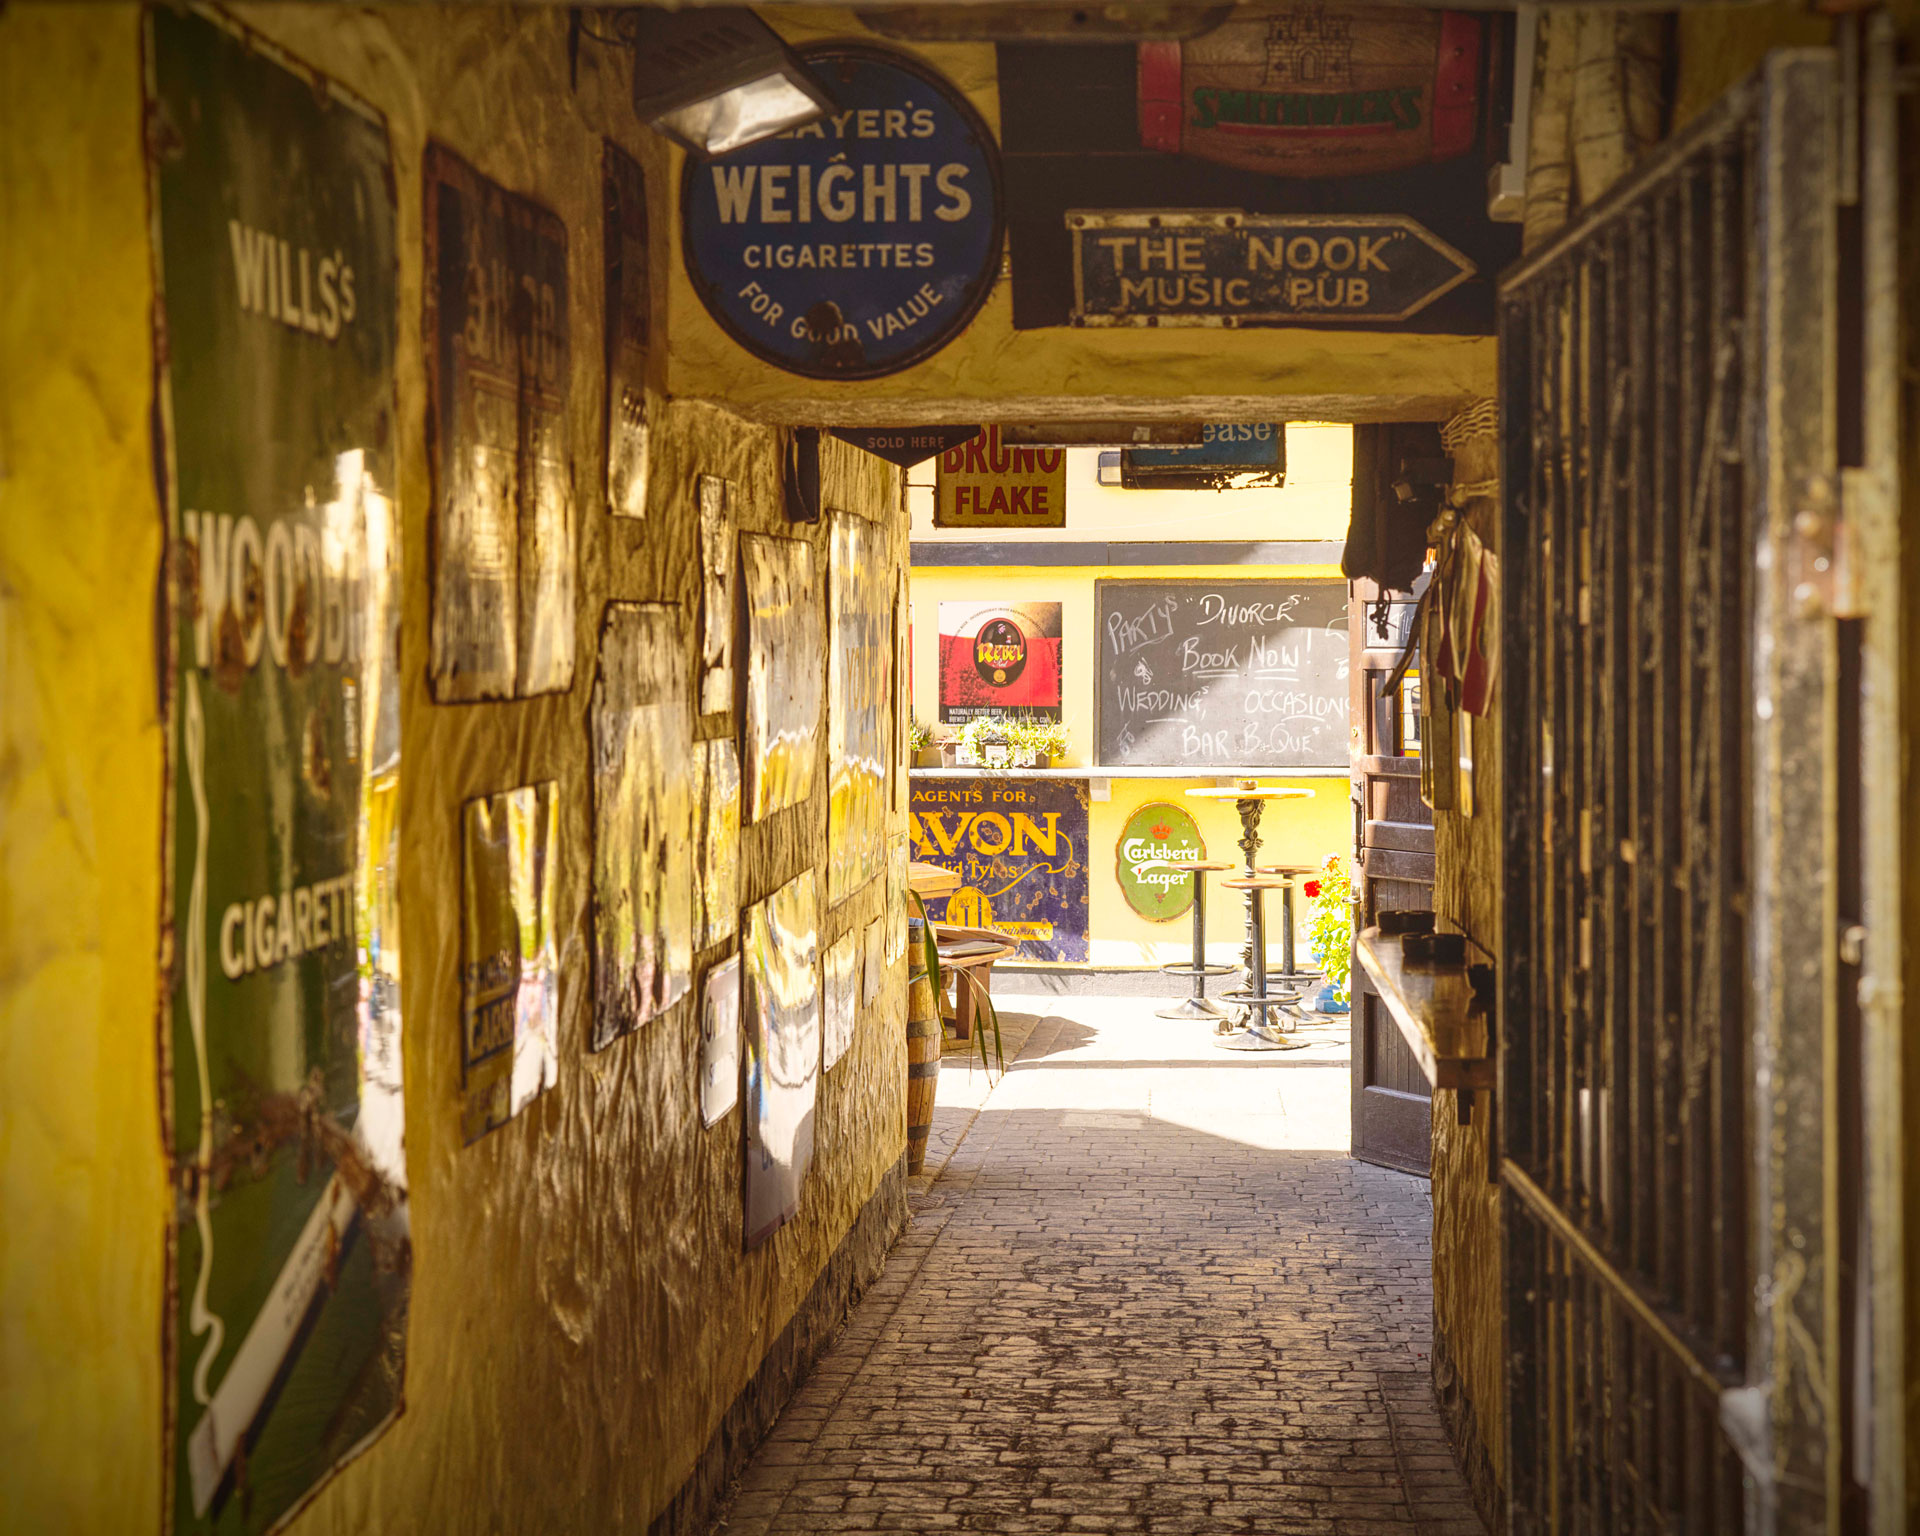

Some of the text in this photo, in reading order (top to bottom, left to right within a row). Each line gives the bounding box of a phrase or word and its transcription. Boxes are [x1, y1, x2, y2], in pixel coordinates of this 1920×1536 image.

[711, 163, 973, 224] WEIGHTS
[743, 243, 935, 269] CIGARETTES
[1099, 231, 1407, 274] THE "NOOK"
[1120, 277, 1370, 308] MUSIC PUB
[738, 281, 784, 327] FOR
[867, 282, 944, 341] VALUE
[867, 436, 945, 449] SOLD HERE
[955, 486, 1049, 515] FLAKE
[912, 790, 1027, 803] AGENTS FOR
[909, 811, 1061, 856] AVON
[1123, 838, 1199, 864] Carlsberg
[1135, 867, 1188, 894] Lager
